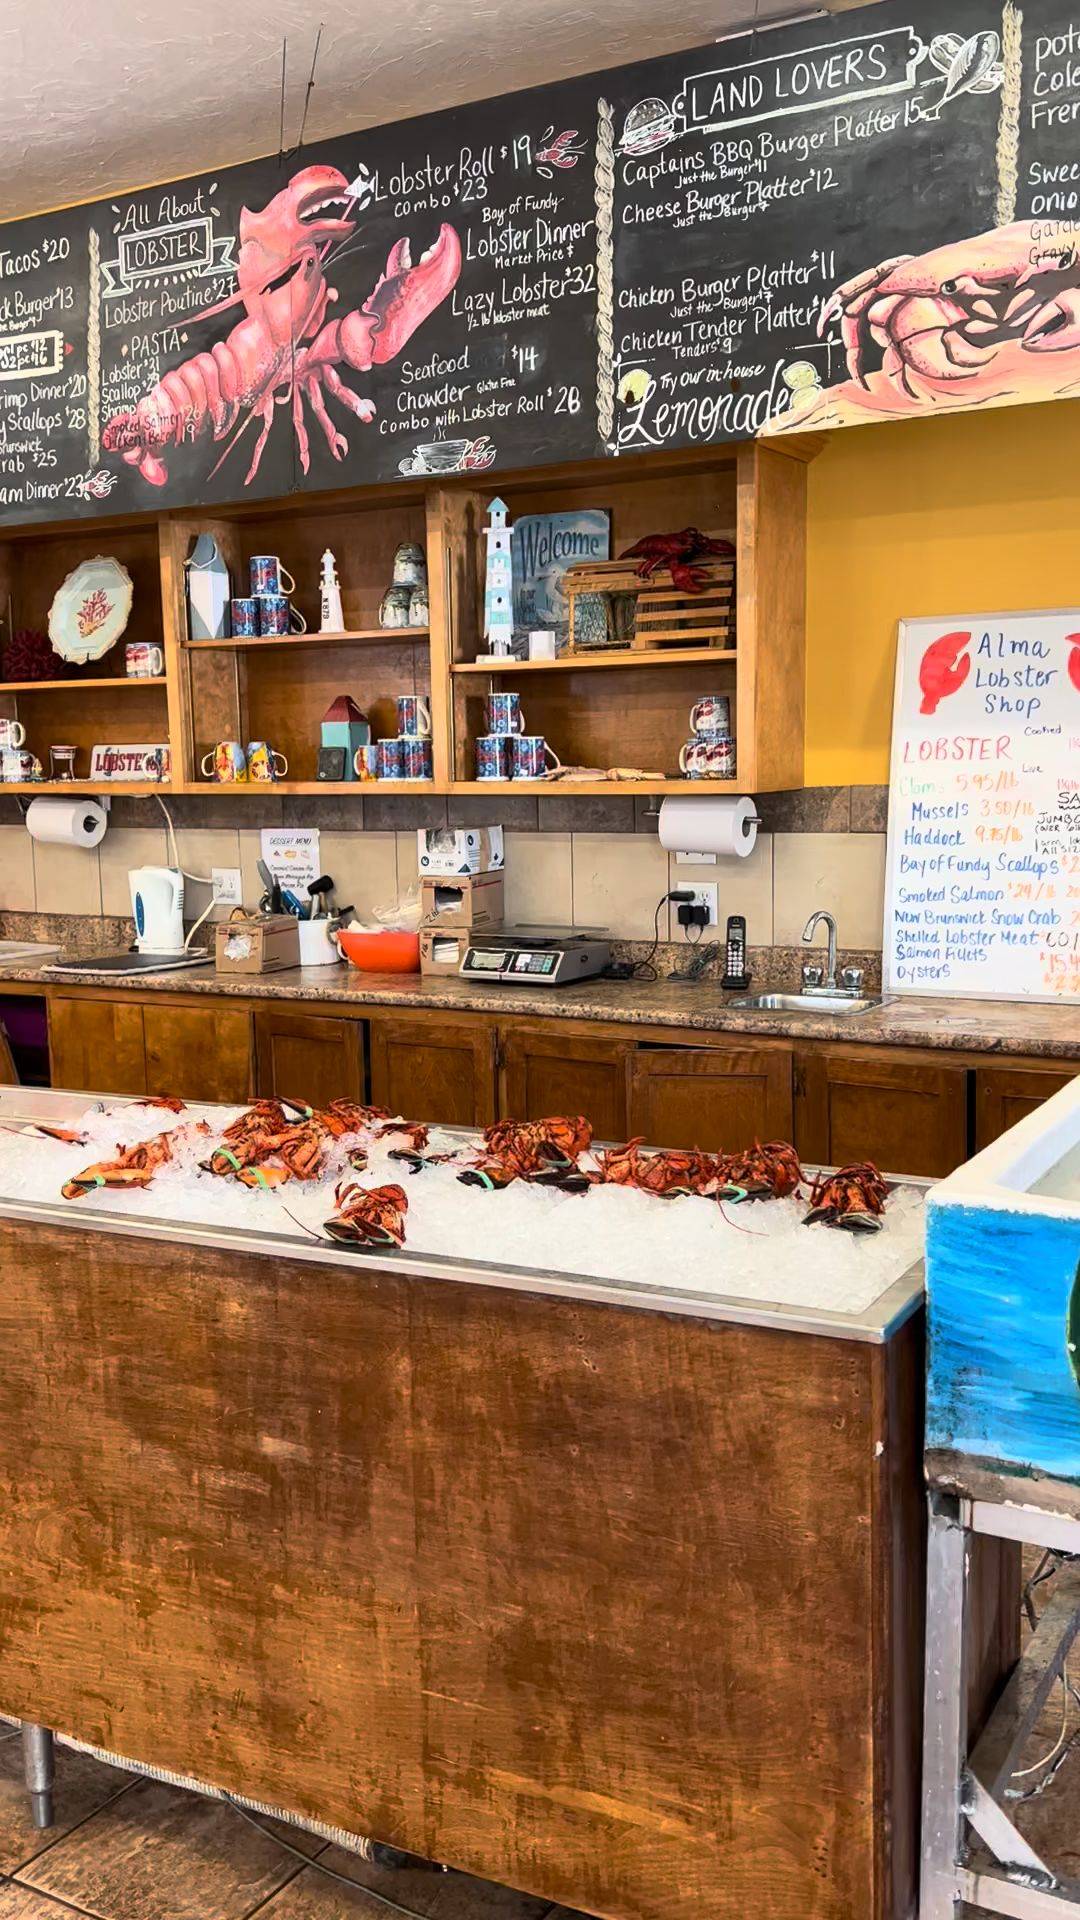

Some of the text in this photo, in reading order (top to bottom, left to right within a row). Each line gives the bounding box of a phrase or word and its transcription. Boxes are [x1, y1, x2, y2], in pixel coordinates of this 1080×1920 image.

[1035, 24, 1080, 72] pot
[691, 44, 887, 121] LAND LOVERS
[623, 151, 705, 188] Captains
[712, 141, 753, 168] BBQ
[758, 131, 828, 161] Burger
[834, 103, 900, 146] Platter
[375, 153, 455, 201] Lobster
[459, 146, 494, 180] Roll
[720, 165, 754, 182] Burger
[121, 190, 206, 231] All About
[482, 192, 564, 226] Bay of Fundy
[622, 204, 681, 225] Cheese
[686, 190, 741, 218] Burger
[743, 176, 812, 204] Platter
[724, 203, 758, 220] Burger
[126, 231, 204, 271] LOBSTER
[466, 217, 595, 261] Lobster Dinner
[495, 254, 534, 269] Market
[537, 249, 564, 264] Price
[452, 289, 494, 317] Lazy
[502, 271, 572, 306] Lobster
[618, 286, 674, 308] Chicken
[682, 276, 741, 306] Burger
[747, 259, 817, 293] Platter
[15, 290, 56, 321] Burger
[105, 296, 158, 329] Lobster
[161, 284, 213, 317] Poutine
[723, 295, 759, 314] Burger
[621, 330, 682, 354] Chicken
[683, 315, 748, 342] Tender
[753, 300, 819, 335] Platter
[131, 328, 181, 360] PASTA
[672, 343, 718, 360] Tenders
[102, 361, 142, 387] Lobster
[401, 346, 471, 385] Seafood
[31, 382, 68, 402] Dinner
[660, 373, 678, 395] Try
[680, 368, 707, 387] our
[397, 383, 471, 413] Chowder
[435, 409, 461, 427] with
[463, 397, 513, 422] Lobster
[517, 394, 544, 413] Roll
[618, 359, 793, 445] Lemonade
[8, 407, 62, 437] Scallops
[26, 481, 64, 500] Dinner
[520, 521, 600, 584] Welcome
[977, 632, 1051, 659] Alma
[975, 665, 1058, 688] Lobster
[985, 693, 1041, 719] Shop
[903, 735, 1013, 764] LOBSTER
[912, 800, 969, 821] Mussels
[904, 826, 966, 846] Haddock
[900, 854, 927, 878] Bay
[929, 853, 945, 873] of
[947, 855, 990, 881] Fundy
[996, 852, 1060, 880] Scallops
[898, 887, 946, 904] Smoked
[951, 885, 1004, 904] Salmon
[895, 910, 921, 925] New
[1028, 908, 1062, 926] Crab
[896, 929, 941, 945] Shelled
[946, 929, 996, 945] Lobster
[1001, 930, 1039, 946] Meat
[895, 944, 941, 961] Salmon
[897, 963, 951, 983] Oysters
